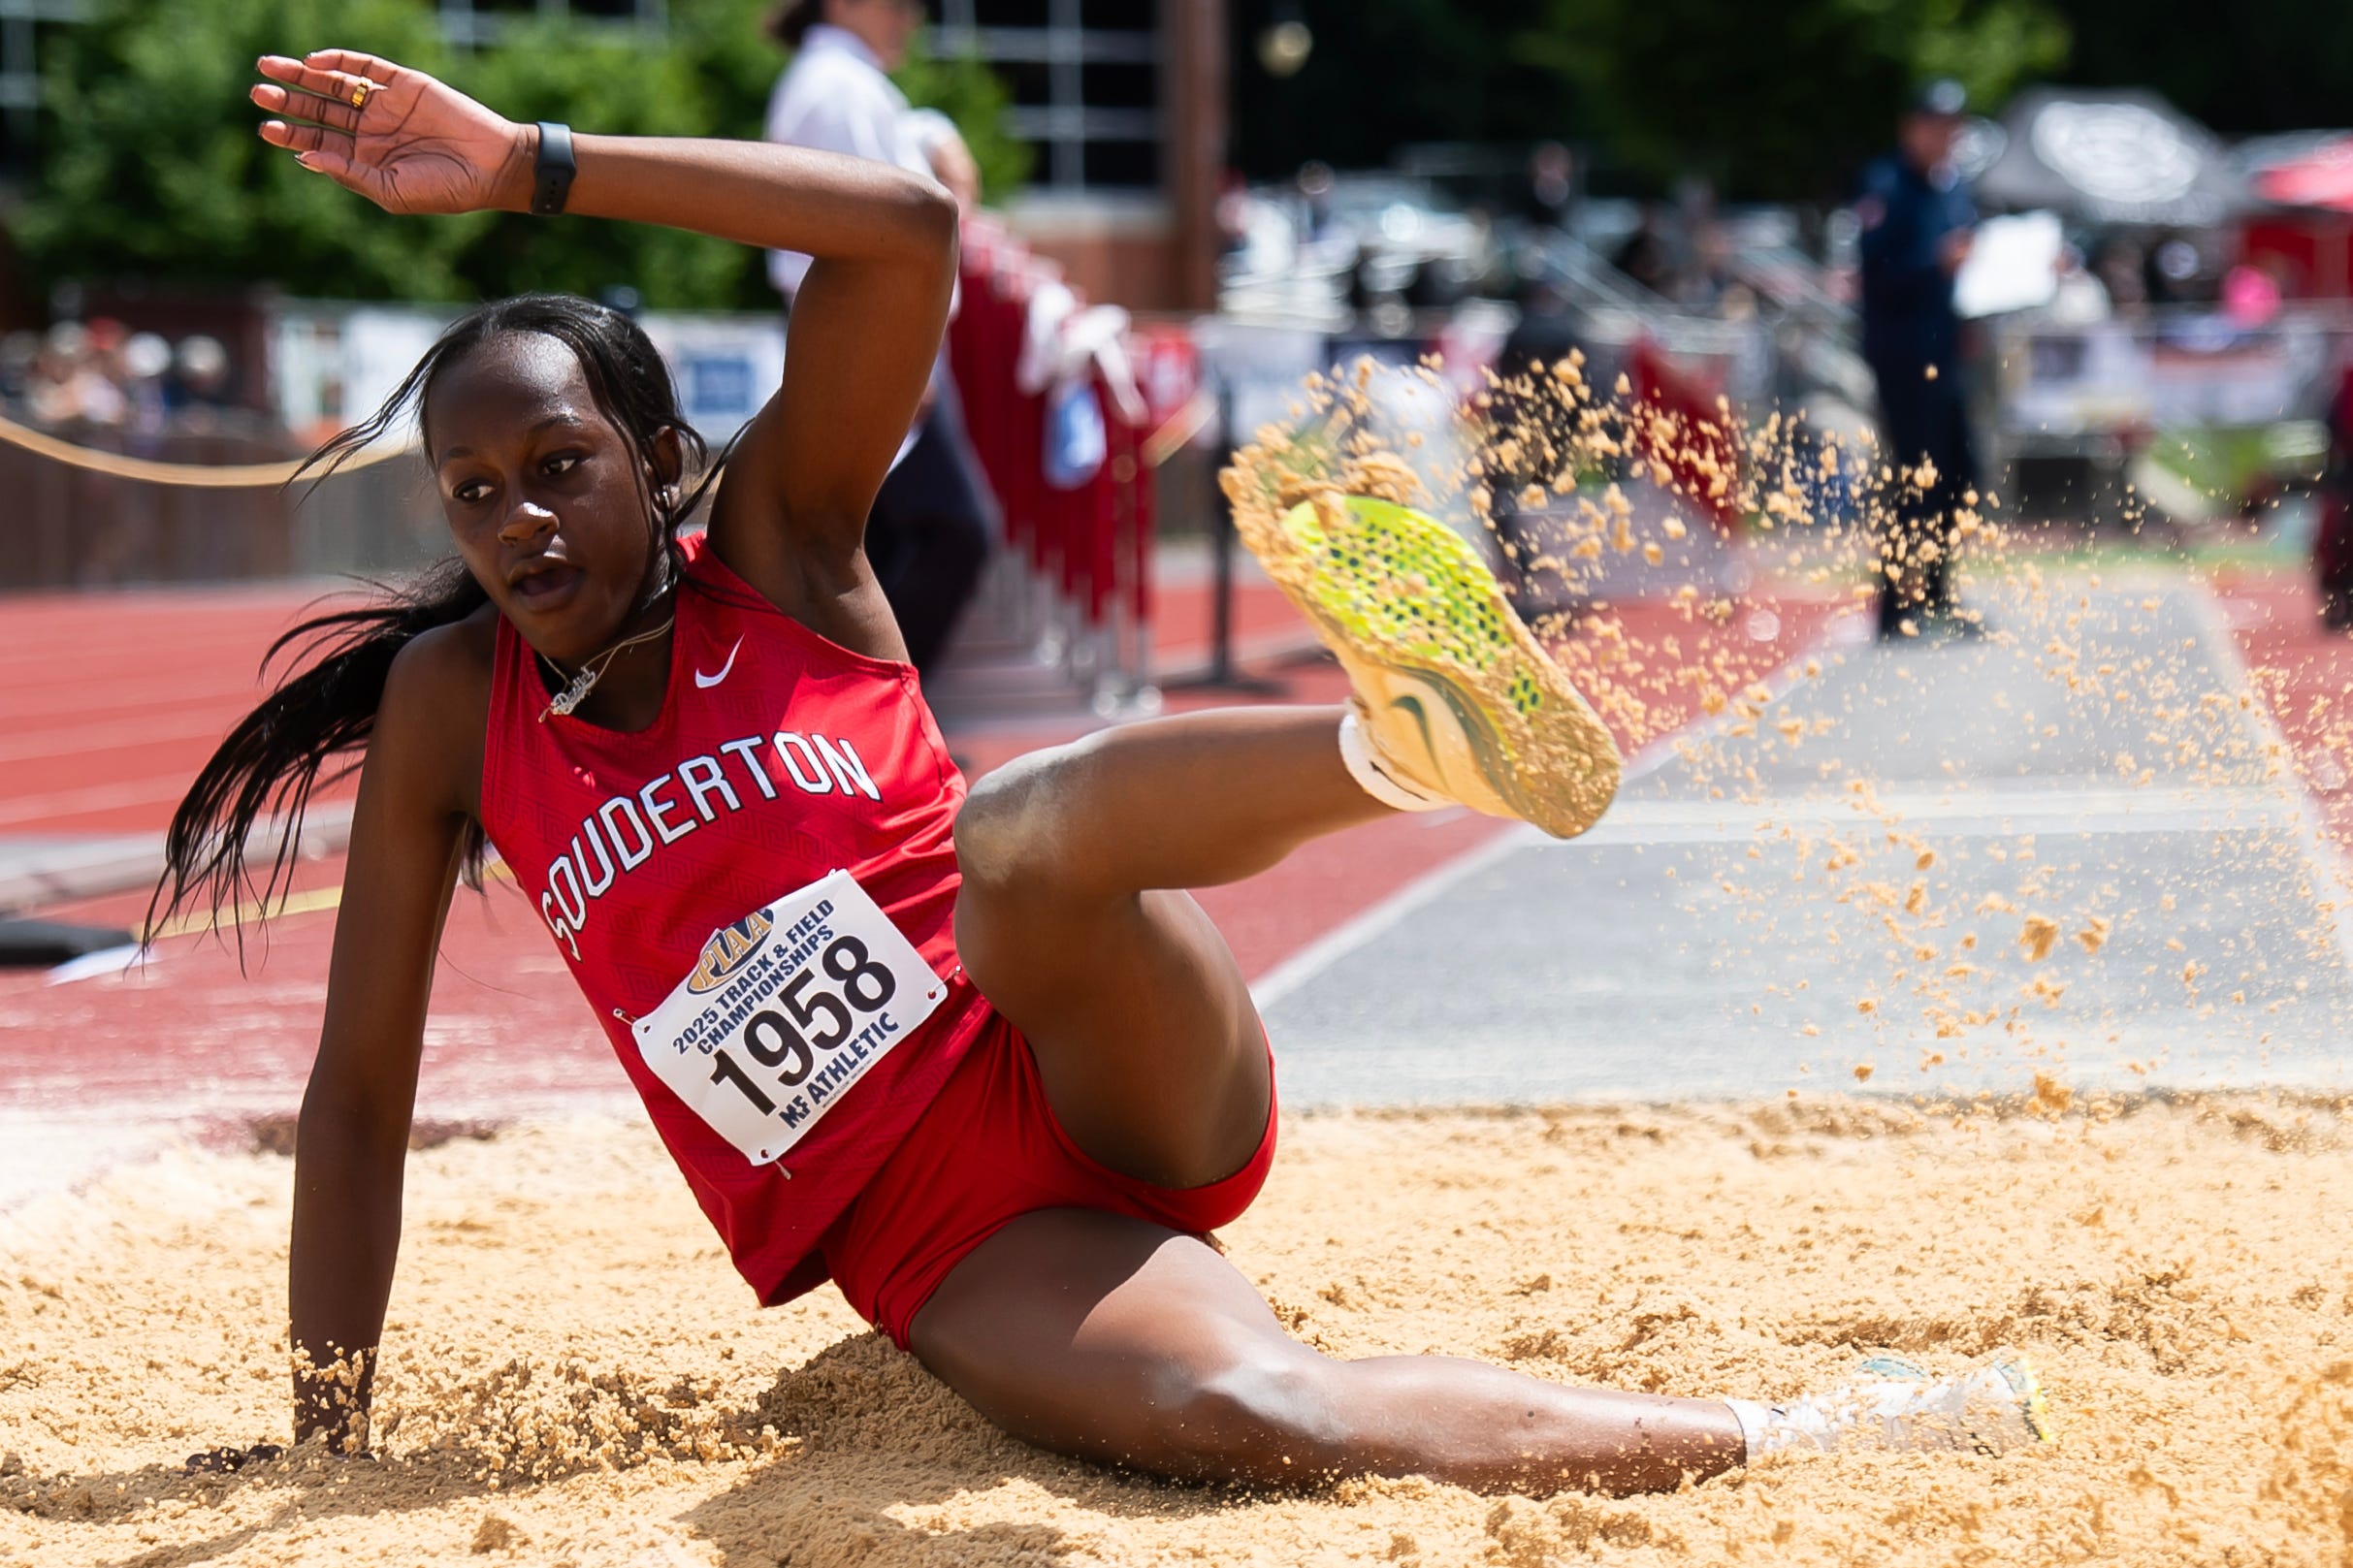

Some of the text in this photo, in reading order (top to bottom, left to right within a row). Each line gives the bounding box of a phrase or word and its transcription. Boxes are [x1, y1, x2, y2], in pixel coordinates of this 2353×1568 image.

[540, 730, 883, 963] SOUDERTON
[672, 899, 834, 1055] 2025 TRACK & FIELD
[697, 911, 772, 987] PIAA
[697, 924, 834, 1055] CHAMPIONSHIPS
[710, 936, 896, 1116] 1958
[779, 1095, 811, 1130] MF
[806, 1011, 899, 1104] ATHLETIC
